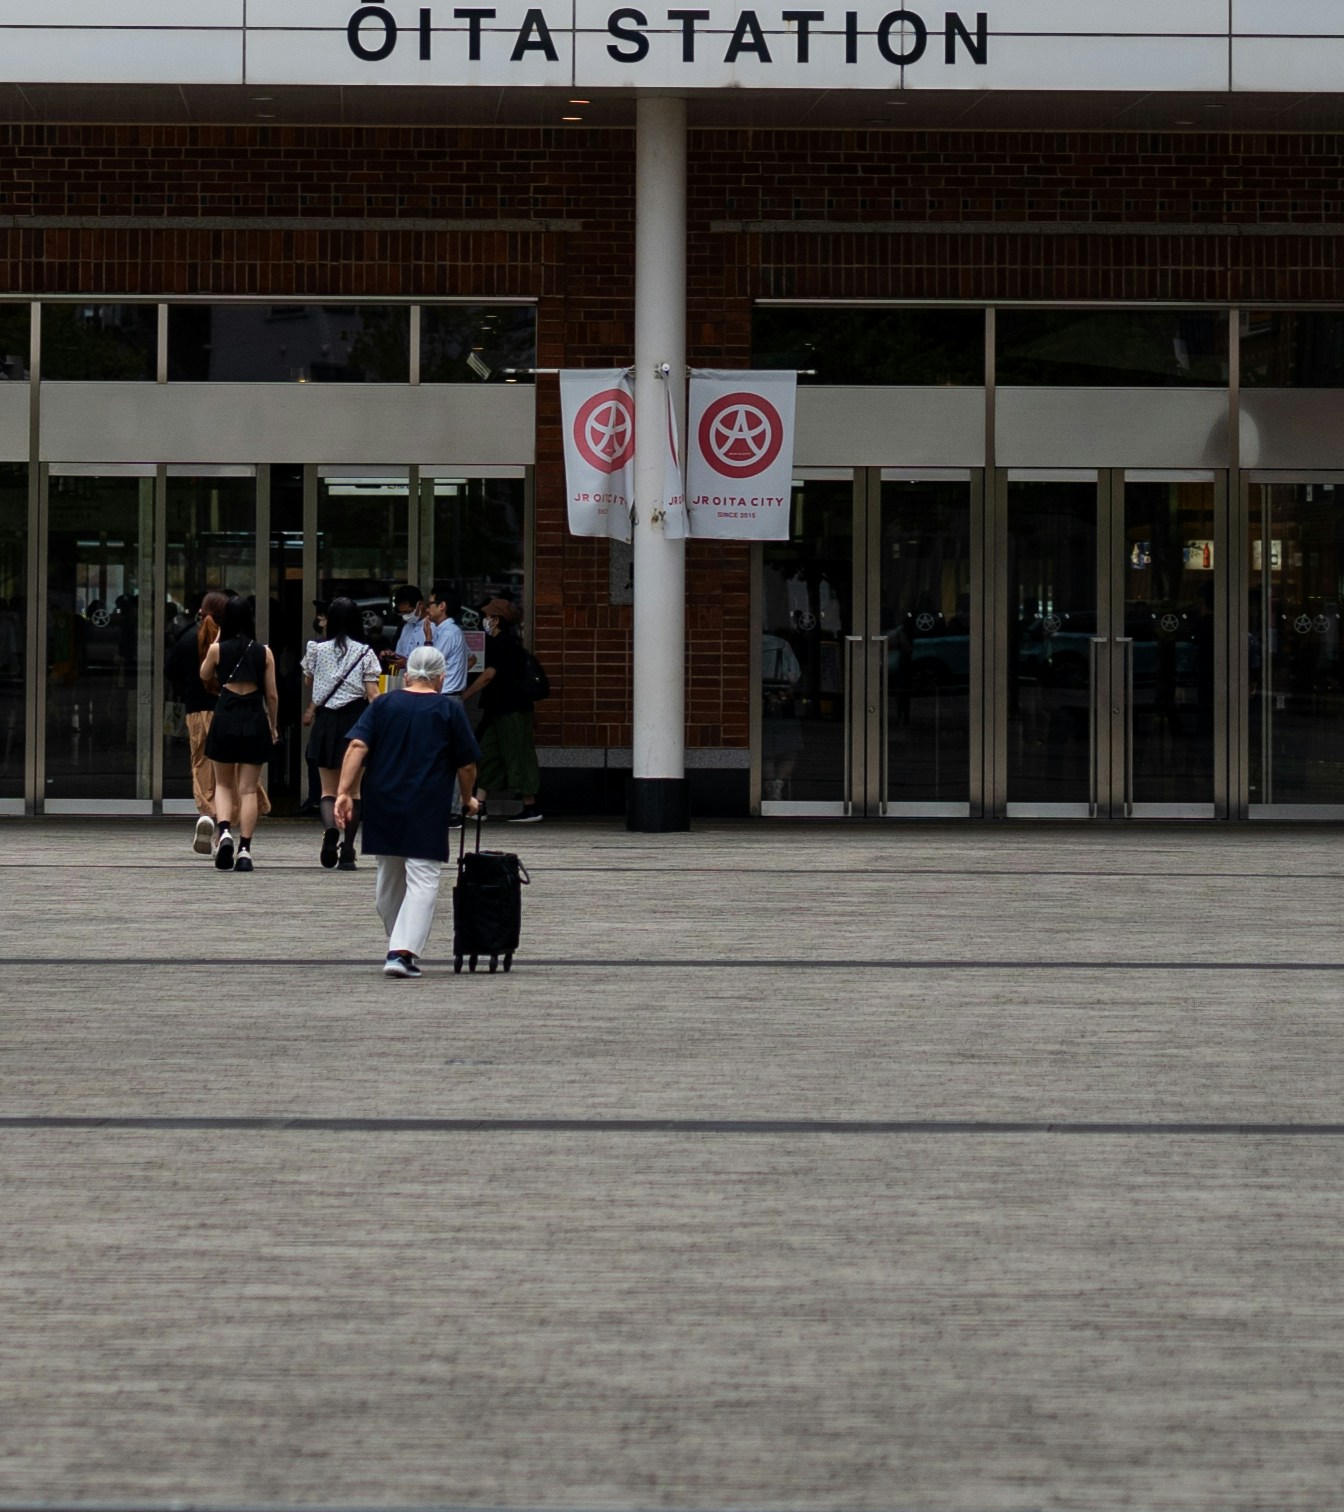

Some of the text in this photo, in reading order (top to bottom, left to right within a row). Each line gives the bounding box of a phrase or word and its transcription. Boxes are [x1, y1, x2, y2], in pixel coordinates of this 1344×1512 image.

[605, 7, 989, 67] STATION
[692, 495, 784, 507] JR OITA CITY
